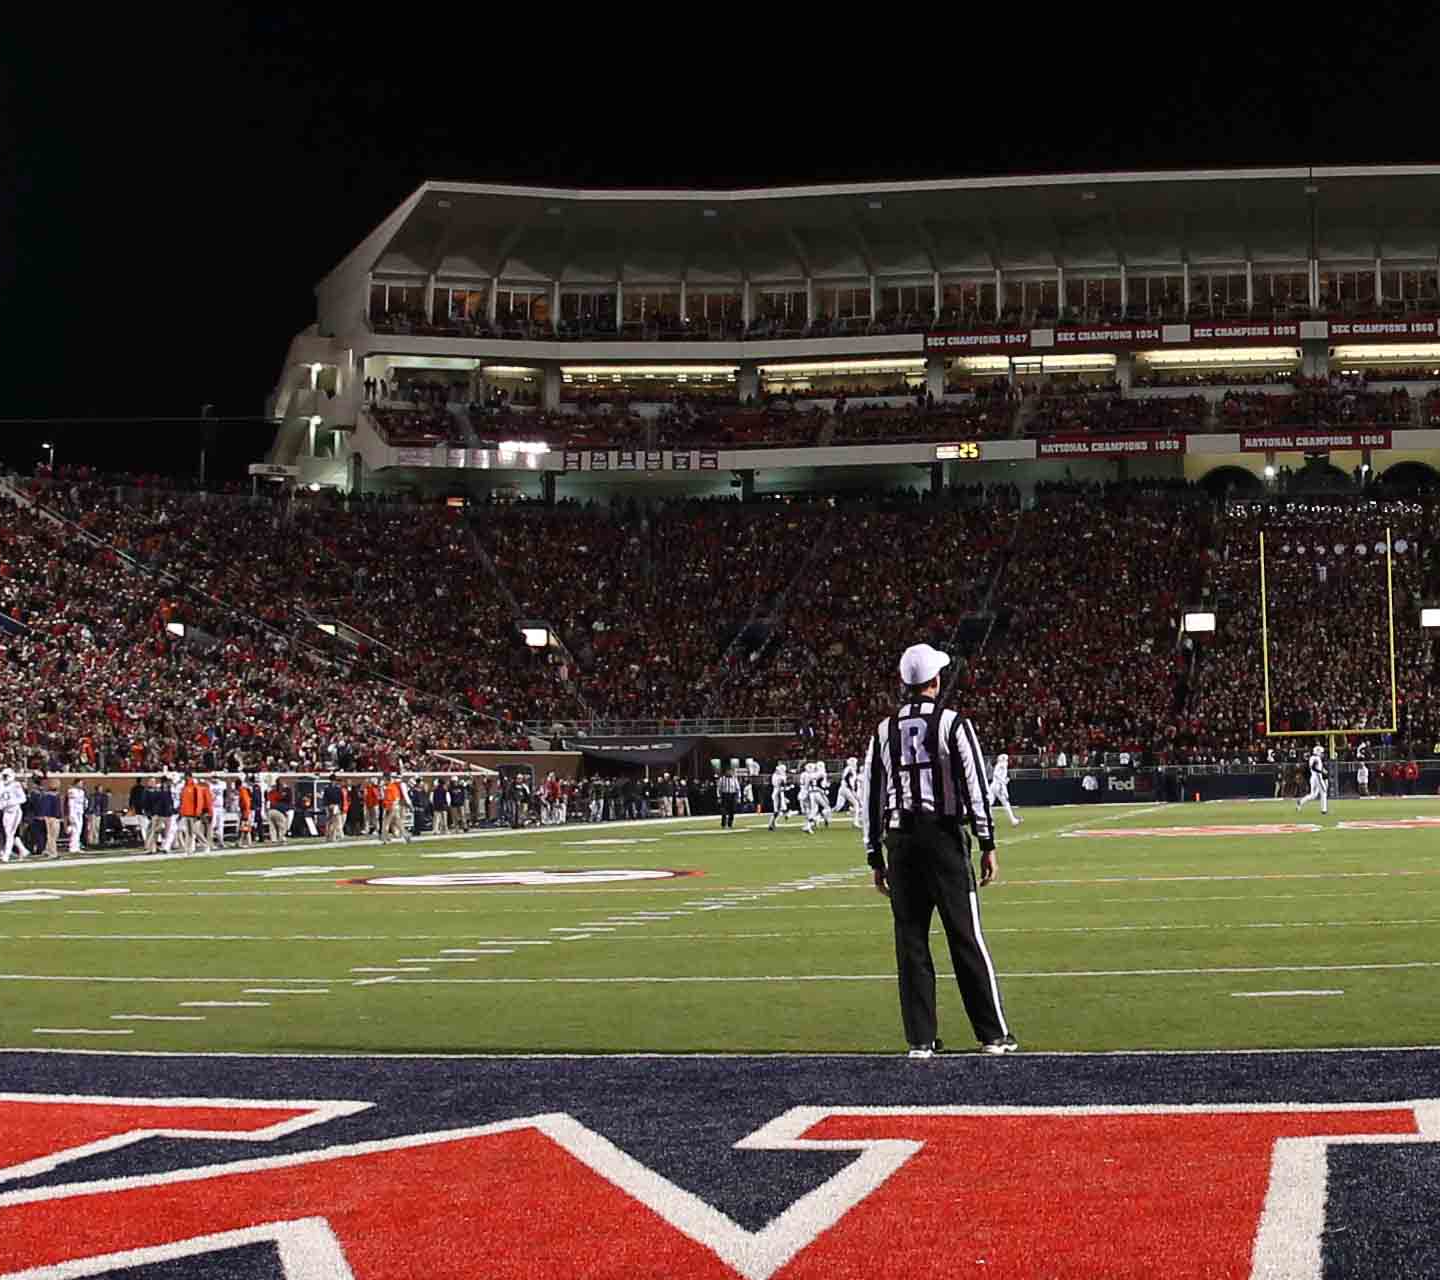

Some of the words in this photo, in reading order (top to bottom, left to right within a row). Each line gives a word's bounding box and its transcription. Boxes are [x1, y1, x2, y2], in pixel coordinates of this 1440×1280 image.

[1194, 328, 1212, 337] SEC
[1215, 327, 1270, 337] CHAMPIONS
[1331, 324, 1350, 334] SEC
[1352, 323, 1407, 333] CHAMPIONS
[927, 336, 945, 346] SEC
[947, 335, 1001, 346] CHAMPIONS
[1057, 332, 1076, 342] SEC
[1078, 331, 1133, 341] CHAMPIONS
[1040, 442, 1088, 454] NATIONAL
[1091, 441, 1148, 452] CHAMPIONS
[1245, 437, 1293, 448] NATIONAL
[1296, 436, 1352, 447] CHAMPIONS
[960, 442, 978, 458] 25
[898, 718, 930, 766] R
[1108, 776, 1151, 791] Fed
